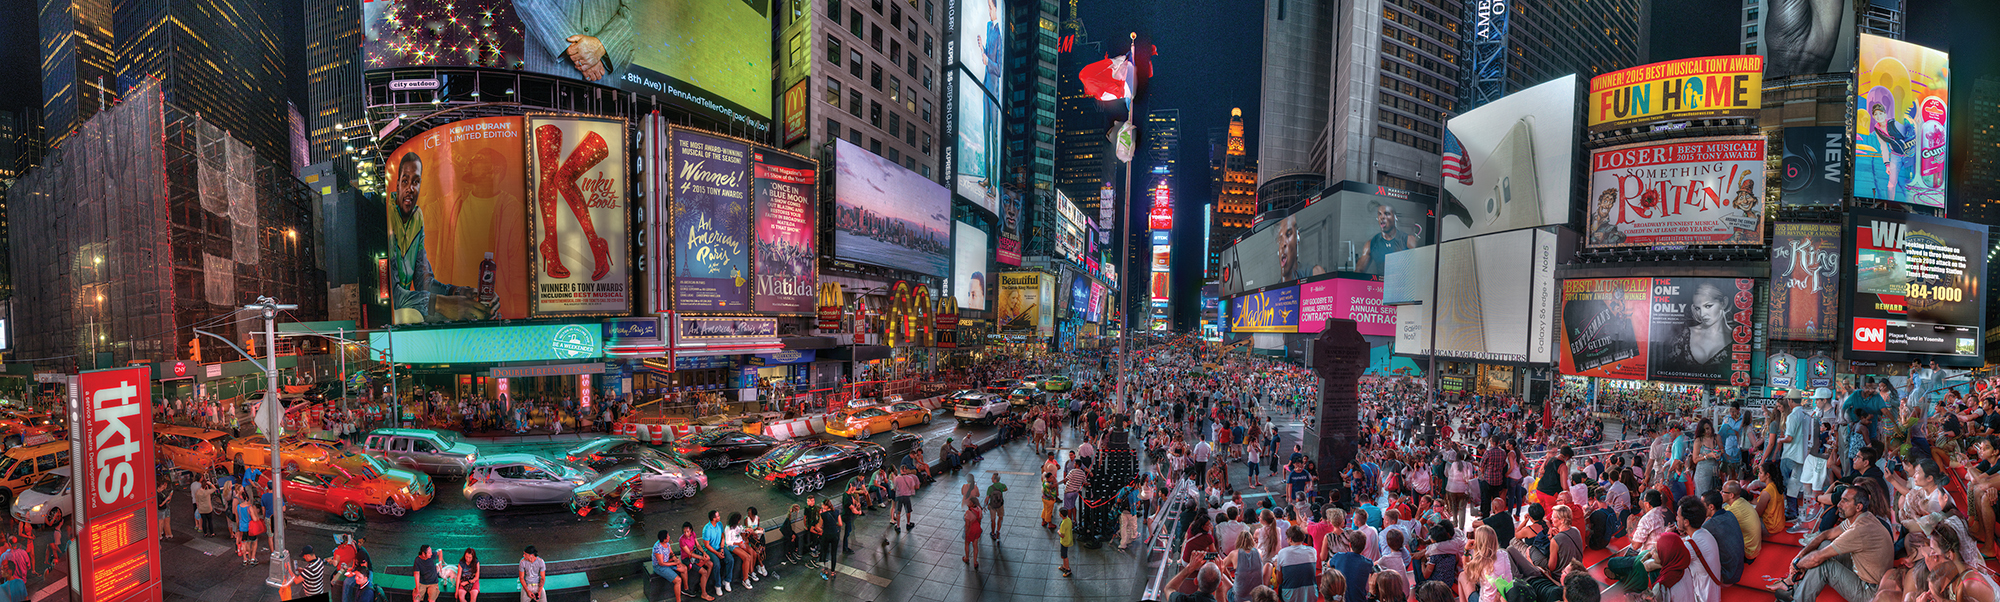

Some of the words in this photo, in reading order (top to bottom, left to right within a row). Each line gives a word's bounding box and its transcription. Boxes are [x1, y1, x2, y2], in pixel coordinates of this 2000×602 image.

[627, 72, 642, 84] 8th
[643, 77, 662, 91] Ave)
[1593, 72, 1625, 91] WINNER!
[1626, 69, 1644, 82] 2015
[1645, 65, 1666, 80] BEST
[1667, 60, 1704, 77] MUSICAL
[1705, 58, 1728, 73] TONY
[1729, 57, 1761, 72] AWARD
[1600, 83, 1651, 121] FUN
[1662, 75, 1749, 111] HOME
[450, 124, 474, 135] KEVIN
[475, 122, 511, 131] DURANT
[789, 117, 801, 132] 24
[450, 131, 482, 143] LIMITED
[482, 130, 518, 140] EDITION
[786, 126, 804, 141] HOURS
[424, 134, 441, 151] ICE
[679, 139, 689, 148] THE
[690, 141, 704, 150] MOST
[704, 144, 743, 158] AWARD-WINNING
[1677, 144, 1702, 154] BEST
[1706, 143, 1757, 153] MUSICAL!
[682, 147, 704, 157] MUSICAL
[712, 152, 721, 161] THE
[722, 154, 742, 165] SEASON!
[1597, 146, 1673, 170] LOSER!
[1676, 153, 1694, 162] 2015
[1698, 152, 1721, 161] TONY
[1723, 151, 1757, 159] AWARD
[1824, 133, 1843, 183] NEW
[680, 160, 745, 188] Winner!
[779, 167, 802, 176] Magazine's
[1626, 162, 1724, 179] SOMETHING
[681, 182, 691, 194] 4
[692, 184, 706, 194] 2015
[707, 186, 721, 196] TONY
[721, 189, 743, 199] AWARDS
[792, 186, 799, 195] IN
[1388, 187, 1410, 196] MARRIOTT
[587, 193, 621, 210] Boots
[636, 130, 645, 271] PALACE
[762, 188, 768, 196] A
[769, 189, 786, 200] BLUE
[787, 193, 809, 205] MOON,
[770, 208, 790, 216] RESTORES
[777, 203, 794, 212] BLAZING
[697, 212, 712, 232] An
[1775, 223, 1786, 231] 2015
[1787, 224, 1800, 232] TONY
[1800, 224, 1819, 232] AWARD
[687, 224, 741, 255] American
[696, 246, 731, 266] Paris
[1773, 246, 1789, 259] The
[1782, 238, 1840, 277] King
[1946, 267, 1963, 275] Station
[541, 283, 570, 292] WINNER!
[571, 283, 576, 292] 6
[577, 283, 595, 292] TONY
[596, 283, 623, 292] AWARDS
[756, 274, 813, 297] Matilda
[1002, 275, 1038, 285] Beautiful
[1565, 280, 1592, 293] BEST
[1594, 279, 1648, 292] MUSICAL!
[1787, 275, 1809, 291] and
[1810, 266, 1823, 295] I
[481, 286, 494, 294] ICE
[1565, 293, 1578, 301] 2014
[1624, 293, 1647, 301] WINNER
[1654, 286, 1680, 295] ONE
[1906, 283, 1962, 303] 384-1000
[1302, 298, 1310, 306] SAY
[1310, 297, 1328, 305] GOODBYE
[1328, 296, 1333, 304] TO
[1302, 305, 1316, 313] ANNUAL
[1316, 304, 1333, 312] SERVICE
[1350, 297, 1365, 305] SAY
[1653, 303, 1687, 313] ONLY
[1874, 303, 1903, 311] REWARD
[1231, 292, 1274, 328] Aladdin
[1301, 312, 1333, 322] CONTRACTS
[1350, 305, 1379, 314] ANNUAL
[1539, 309, 1546, 320] S6
[700, 321, 734, 336] American
[738, 321, 756, 335] Paris
[1571, 308, 1611, 354] GENTLEMAN'S
[1730, 278, 1755, 387] CHICAGO
[1855, 327, 1884, 343] CNN
[1538, 320, 1547, 354] Galaxy
[1588, 335, 1612, 350] GUIDE
[1904, 333, 1918, 341] found
[564, 343, 593, 352] WEEKENDER
[1454, 350, 1477, 358] EAGLE
[1477, 352, 1527, 362] OUTFITTERS
[1657, 370, 1722, 379] CHICAGOTHEMUSICAL.COM
[1611, 380, 1642, 390] GRAND
[1659, 383, 1688, 393] SLAM
[93, 380, 141, 504] tkts
[88, 451, 96, 492] Development
